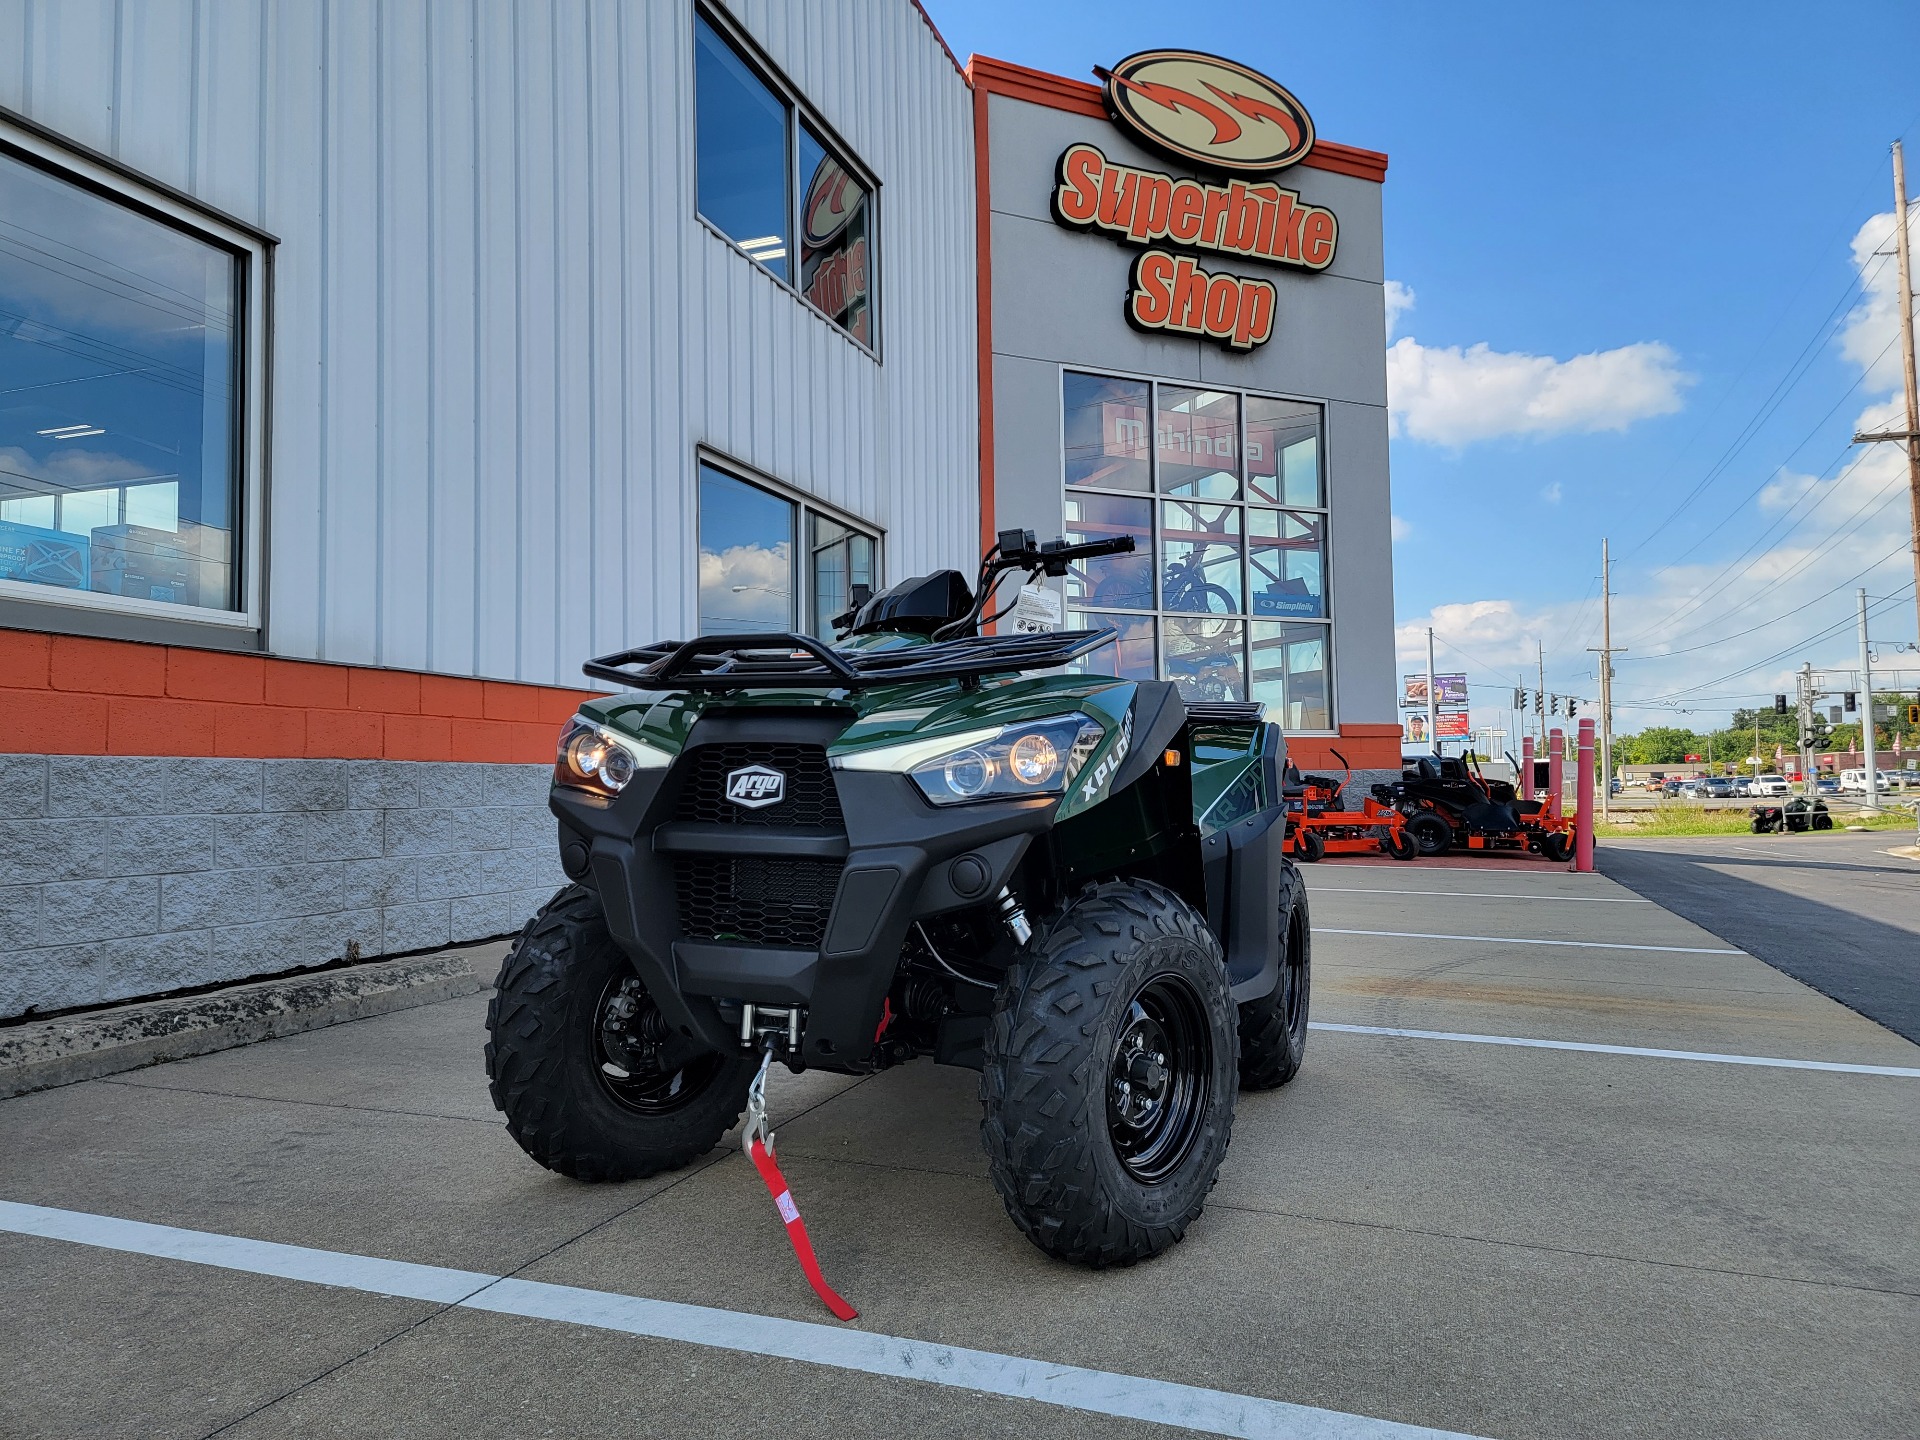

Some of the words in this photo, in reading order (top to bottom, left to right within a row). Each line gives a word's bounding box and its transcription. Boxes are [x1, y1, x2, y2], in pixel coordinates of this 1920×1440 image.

[1061, 149, 1335, 265] Superbike
[1135, 254, 1273, 345] Shop
[1115, 416, 1263, 462] Mhinda
[730, 774, 781, 798] Argo
